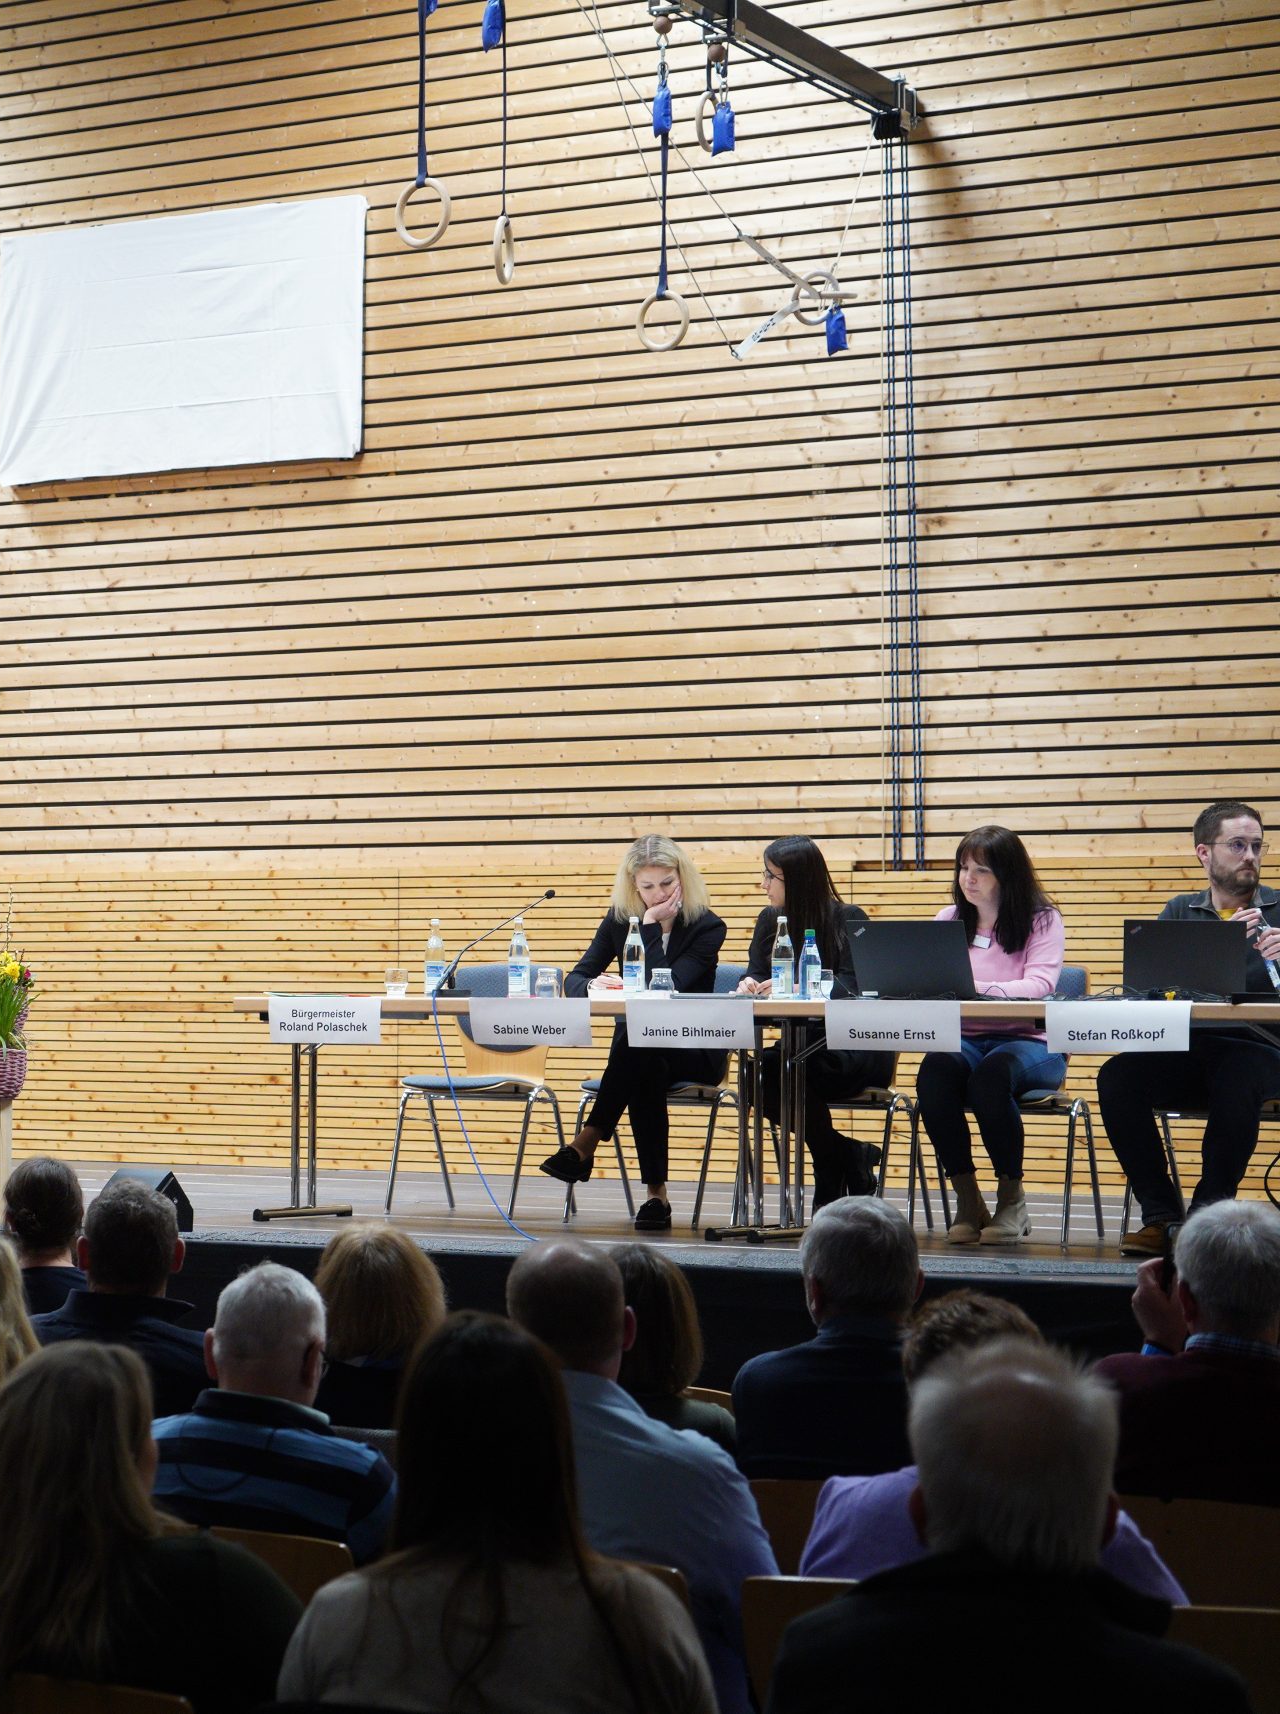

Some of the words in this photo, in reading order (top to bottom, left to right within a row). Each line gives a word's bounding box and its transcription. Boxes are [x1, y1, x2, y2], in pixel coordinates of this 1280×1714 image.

[291, 1009, 356, 1020] Bürgermeister
[279, 1021, 314, 1032] Roland
[316, 1021, 368, 1032] Polaschek
[493, 1024, 529, 1035] Sabine
[531, 1024, 567, 1035] Weber
[642, 1026, 679, 1037] Janine
[681, 1027, 736, 1038] Bihlmaier
[848, 1028, 900, 1040] Susanne
[903, 1029, 936, 1040] Ernst
[1067, 1029, 1107, 1041] Stefan
[1111, 1027, 1166, 1042] Roßkopf
